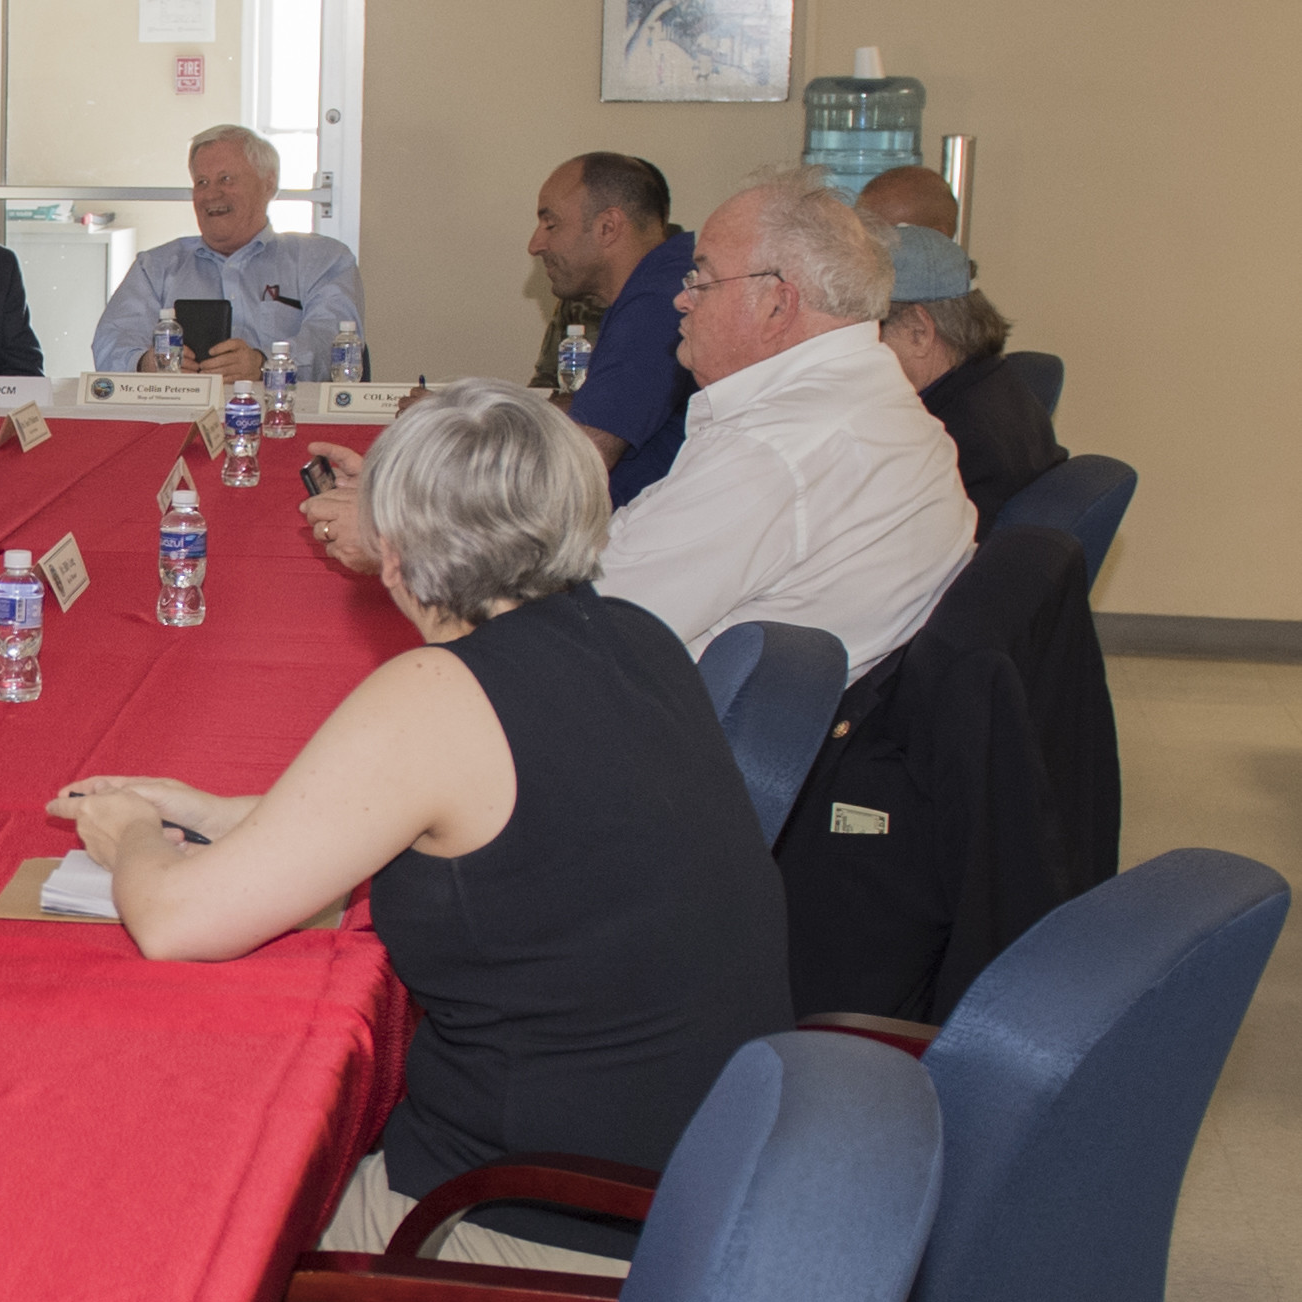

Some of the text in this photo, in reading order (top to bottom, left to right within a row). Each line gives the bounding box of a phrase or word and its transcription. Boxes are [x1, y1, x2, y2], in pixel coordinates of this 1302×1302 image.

[178, 61, 201, 76] FIRE
[120, 384, 200, 393] Mr. Collin Peterson
[363, 393, 384, 401] COL
